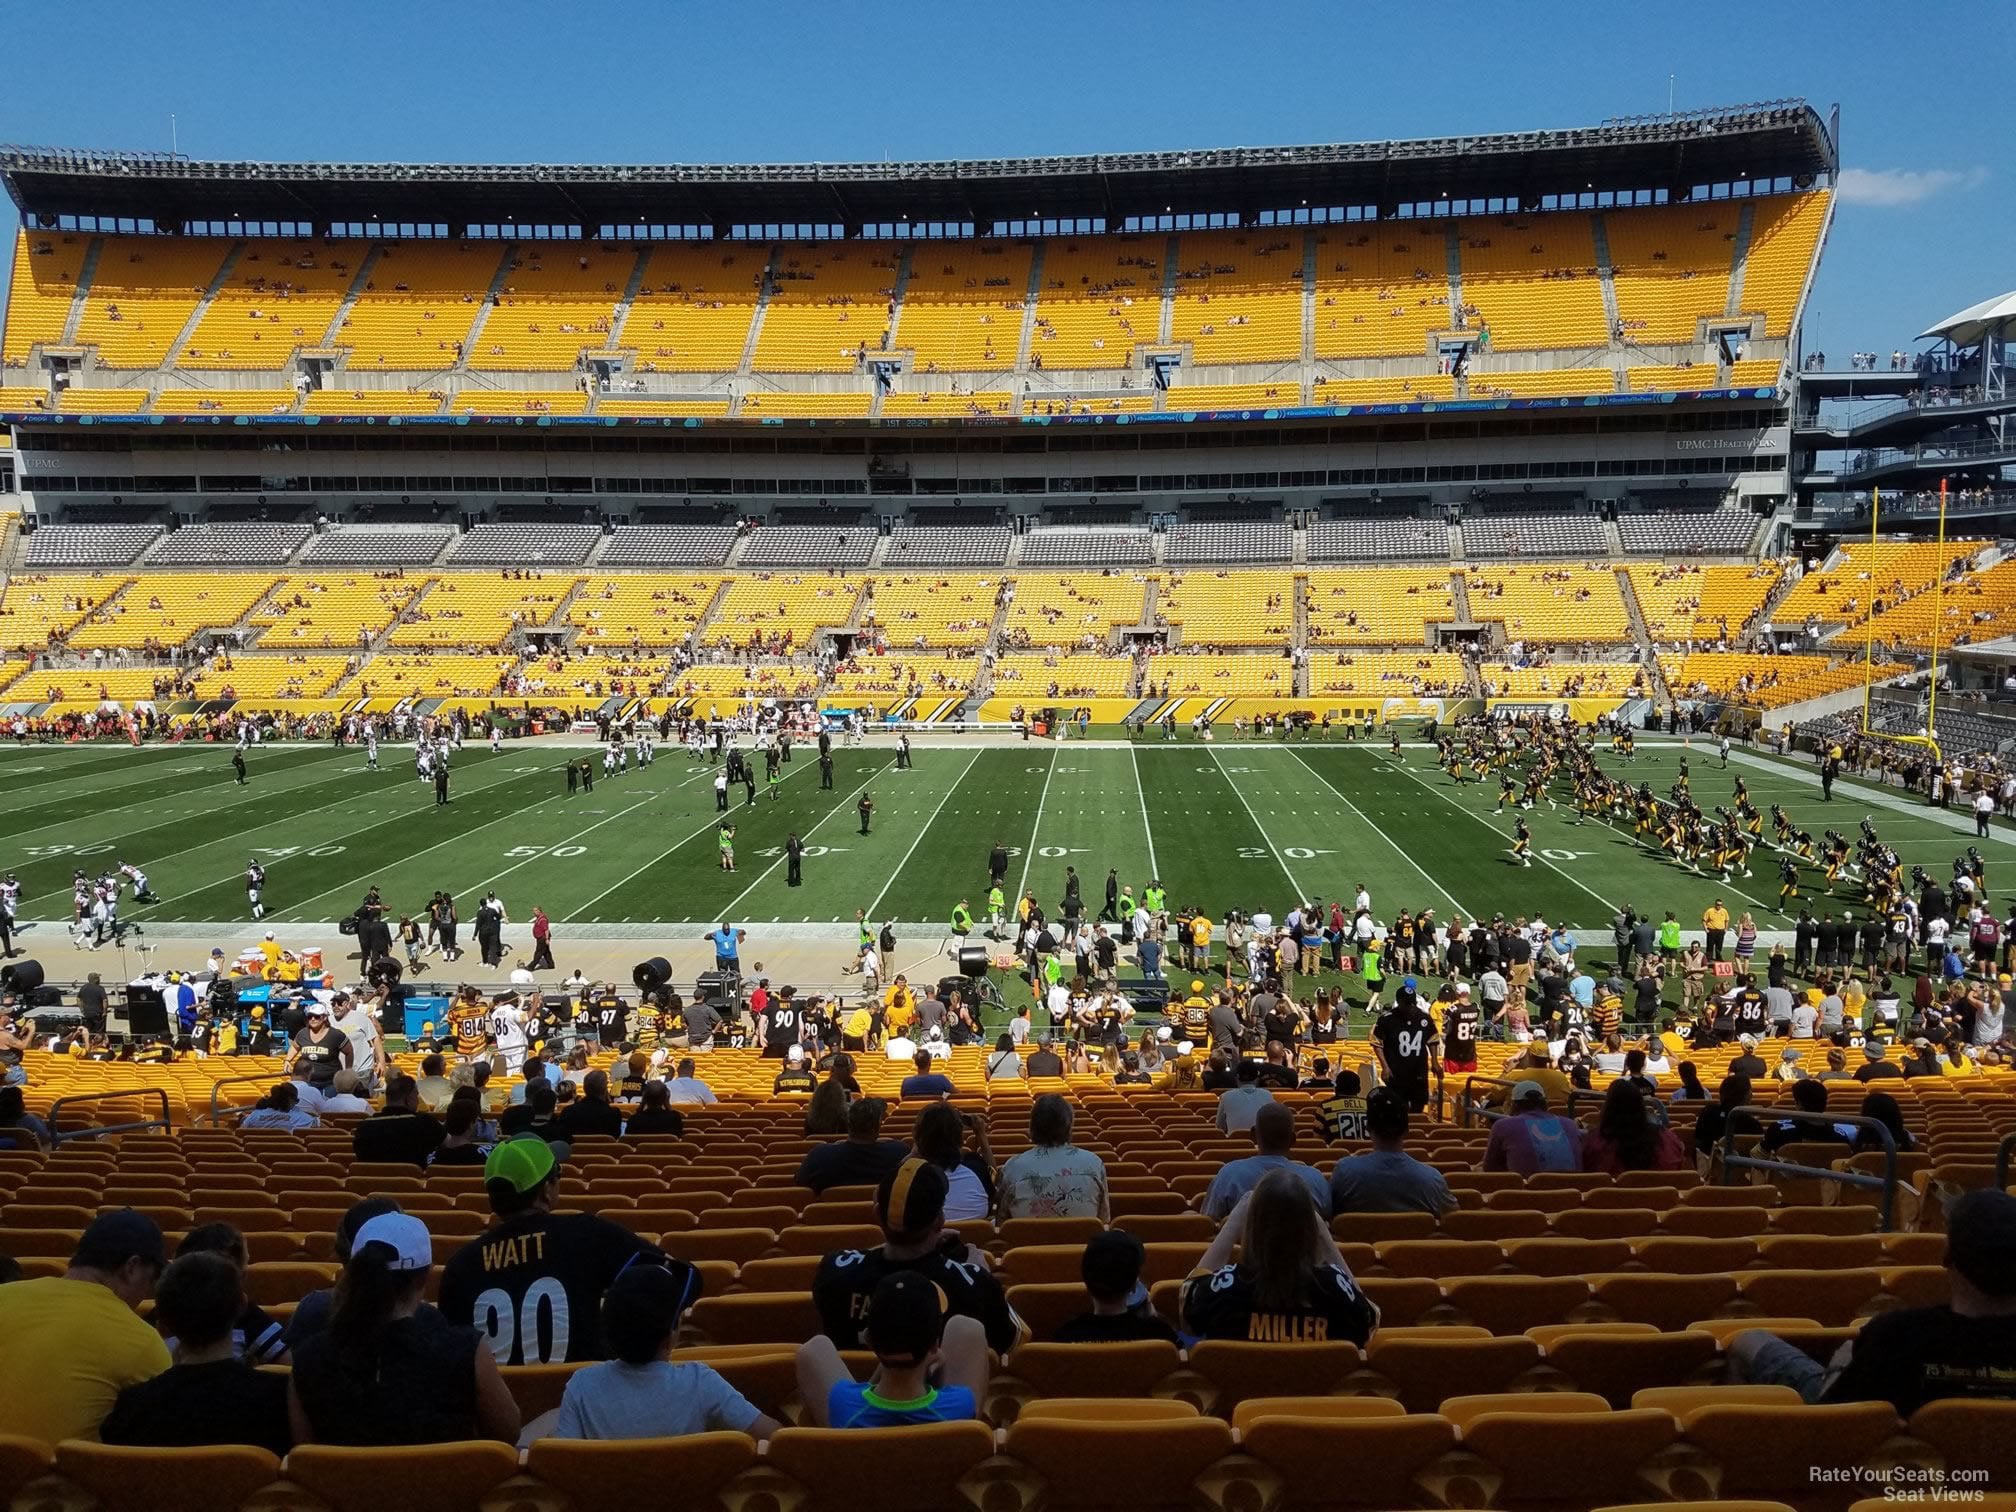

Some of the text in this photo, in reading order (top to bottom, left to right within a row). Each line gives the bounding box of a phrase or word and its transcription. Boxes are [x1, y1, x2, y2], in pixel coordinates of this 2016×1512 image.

[1677, 439, 1711, 450] UPMC
[26, 459, 60, 469] UPMC
[27, 845, 117, 856] 30
[265, 846, 347, 857] 40
[503, 846, 588, 857] 50
[753, 846, 829, 857] 40
[1236, 847, 1316, 858] 20
[1893, 920, 1906, 934] 43
[998, 955, 1010, 965] 30
[1718, 964, 1732, 975] 10
[1188, 1008, 1205, 1020] 83
[1568, 1008, 1583, 1024] 26
[1724, 1004, 1733, 1015] 7
[1742, 1002, 1762, 1020] 86
[601, 1010, 617, 1025] 97
[775, 1010, 793, 1028] 90
[1103, 1018, 1110, 1030] 7
[191, 1025, 204, 1039] 13
[494, 1017, 509, 1036] 86
[805, 1022, 818, 1036] 90
[250, 1031, 257, 1045] 7
[730, 1035, 745, 1048] 92
[1398, 1030, 1423, 1058] 84
[1344, 1099, 1364, 1109] BELL
[482, 1231, 546, 1272] WATT
[473, 1276, 569, 1366] 90
[1248, 1312, 1329, 1343] MILLER
